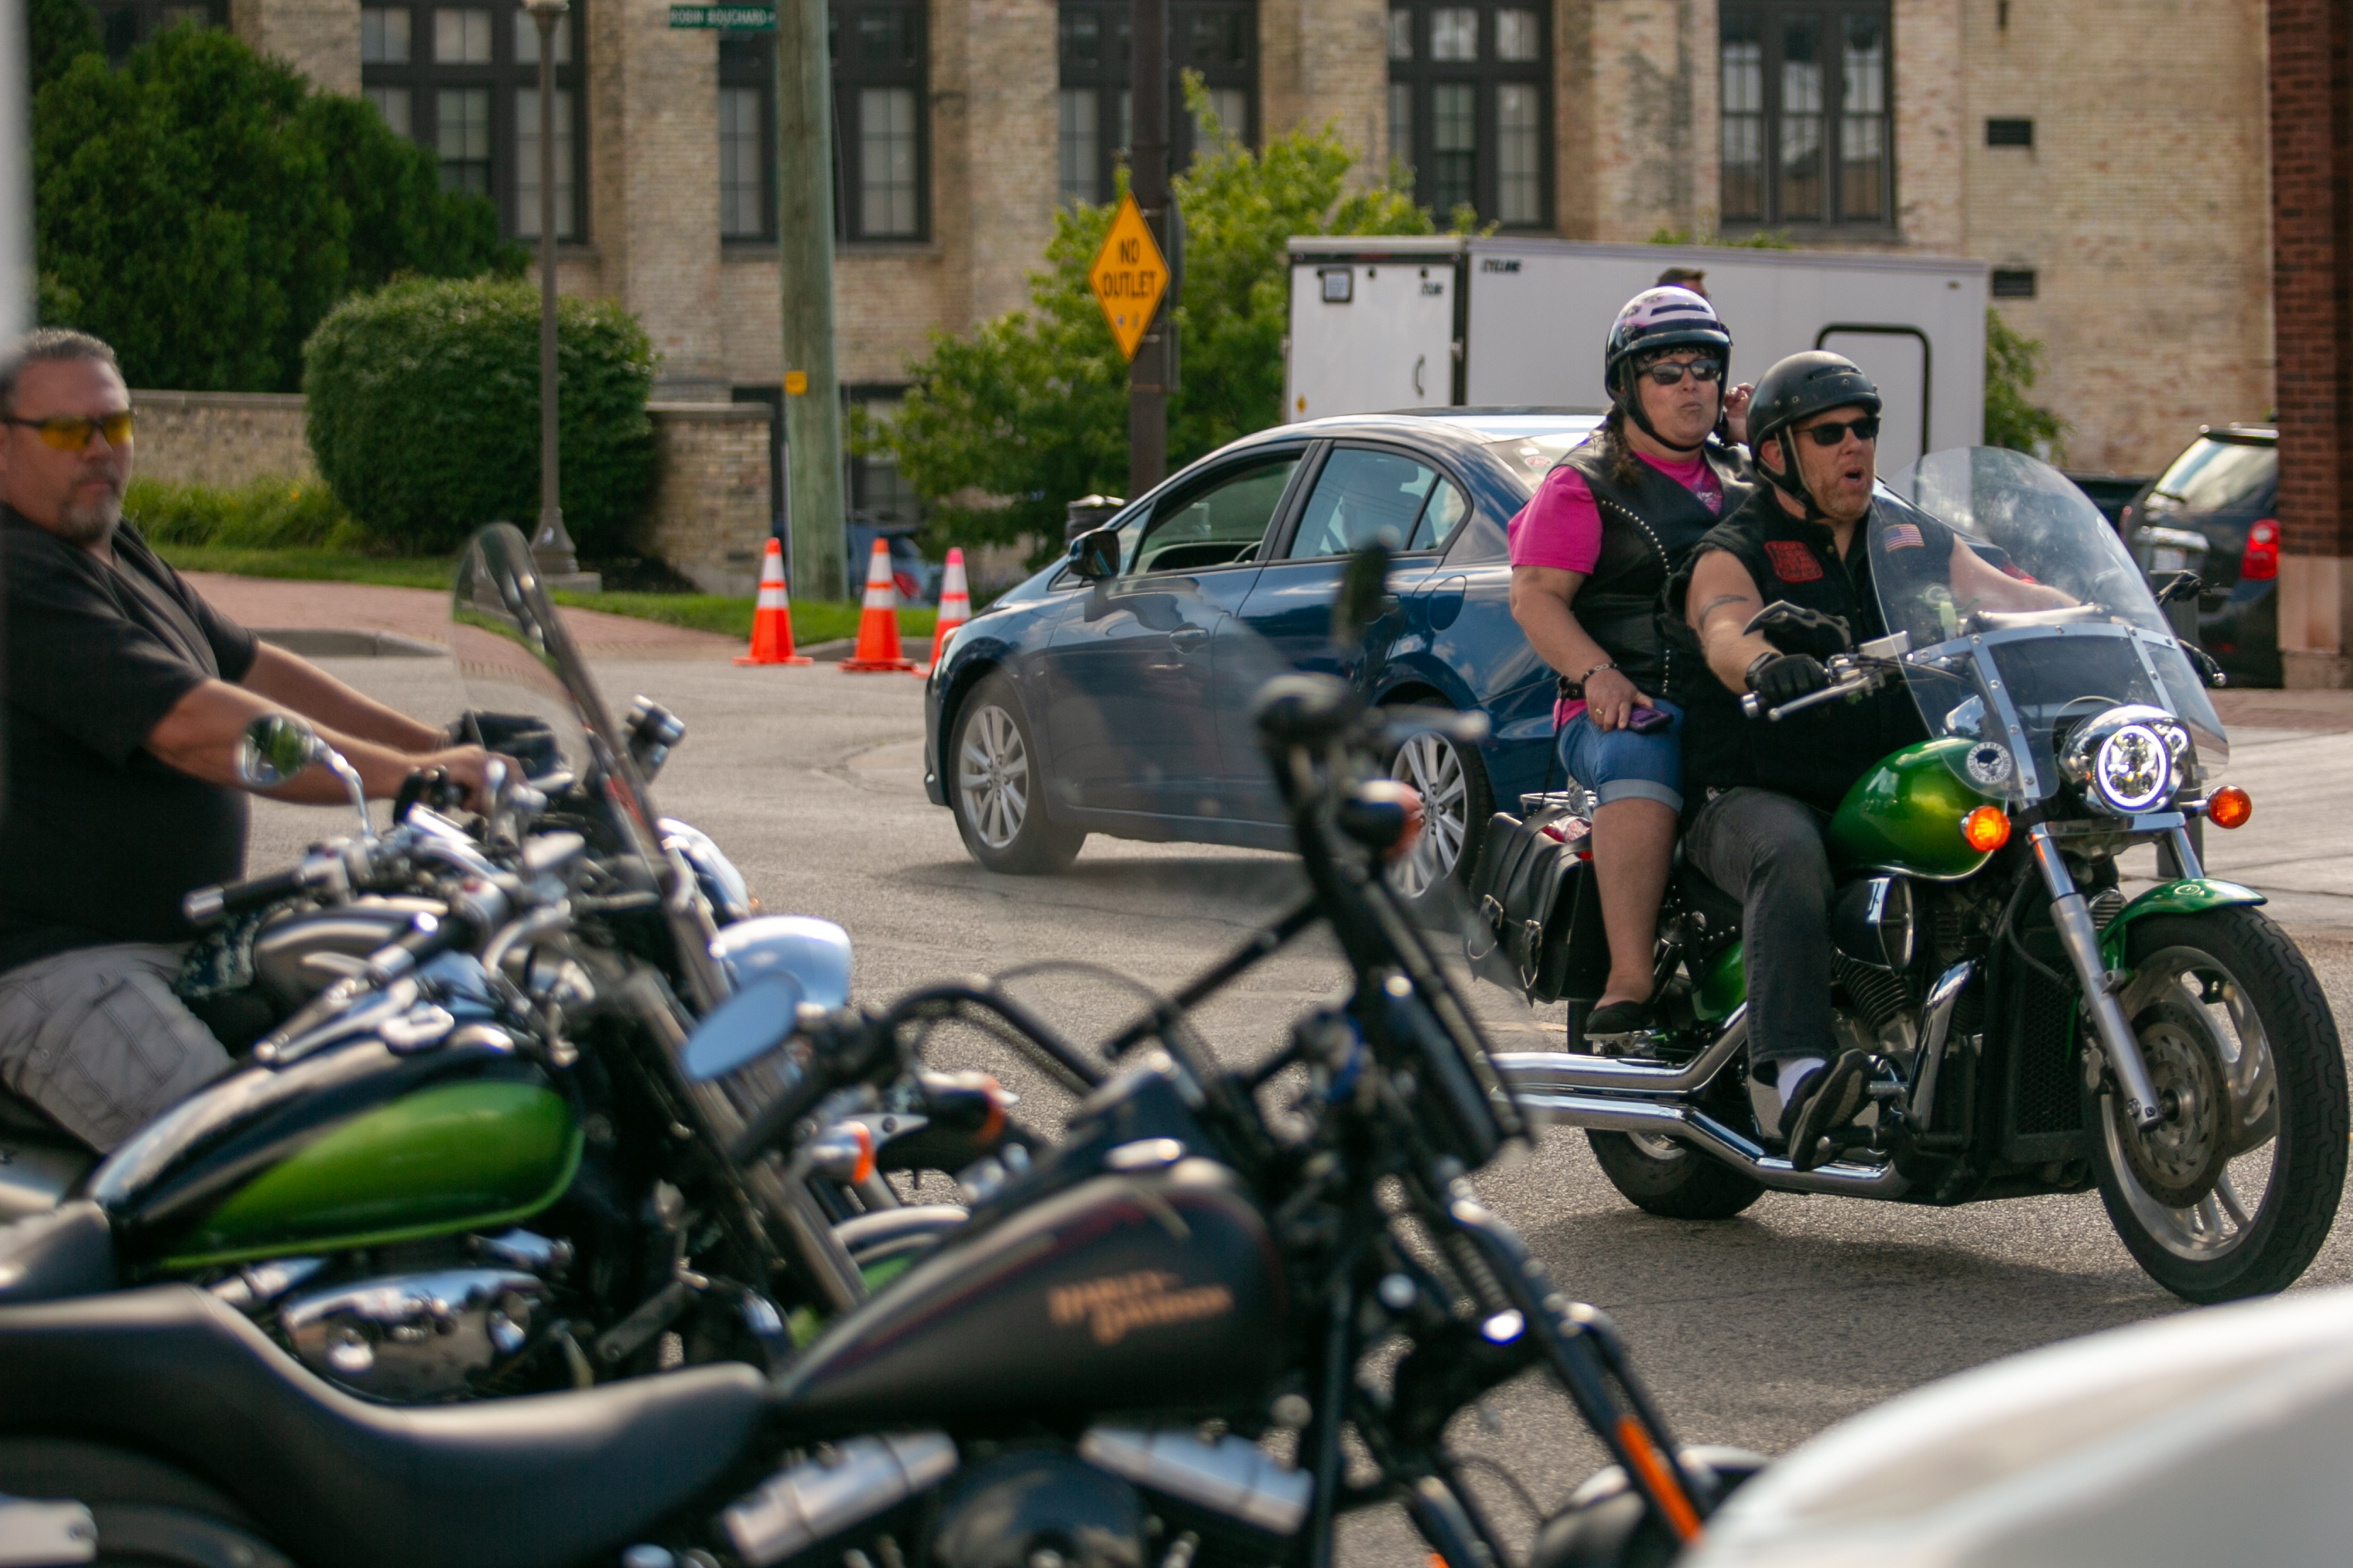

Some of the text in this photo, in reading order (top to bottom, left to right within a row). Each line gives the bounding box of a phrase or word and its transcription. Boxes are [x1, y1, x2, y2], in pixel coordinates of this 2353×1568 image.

[671, 8, 704, 24] ROBIN
[707, 8, 767, 25] BOUCHARD
[1120, 237, 1141, 265] NO
[1103, 270, 1157, 298] OUTLET
